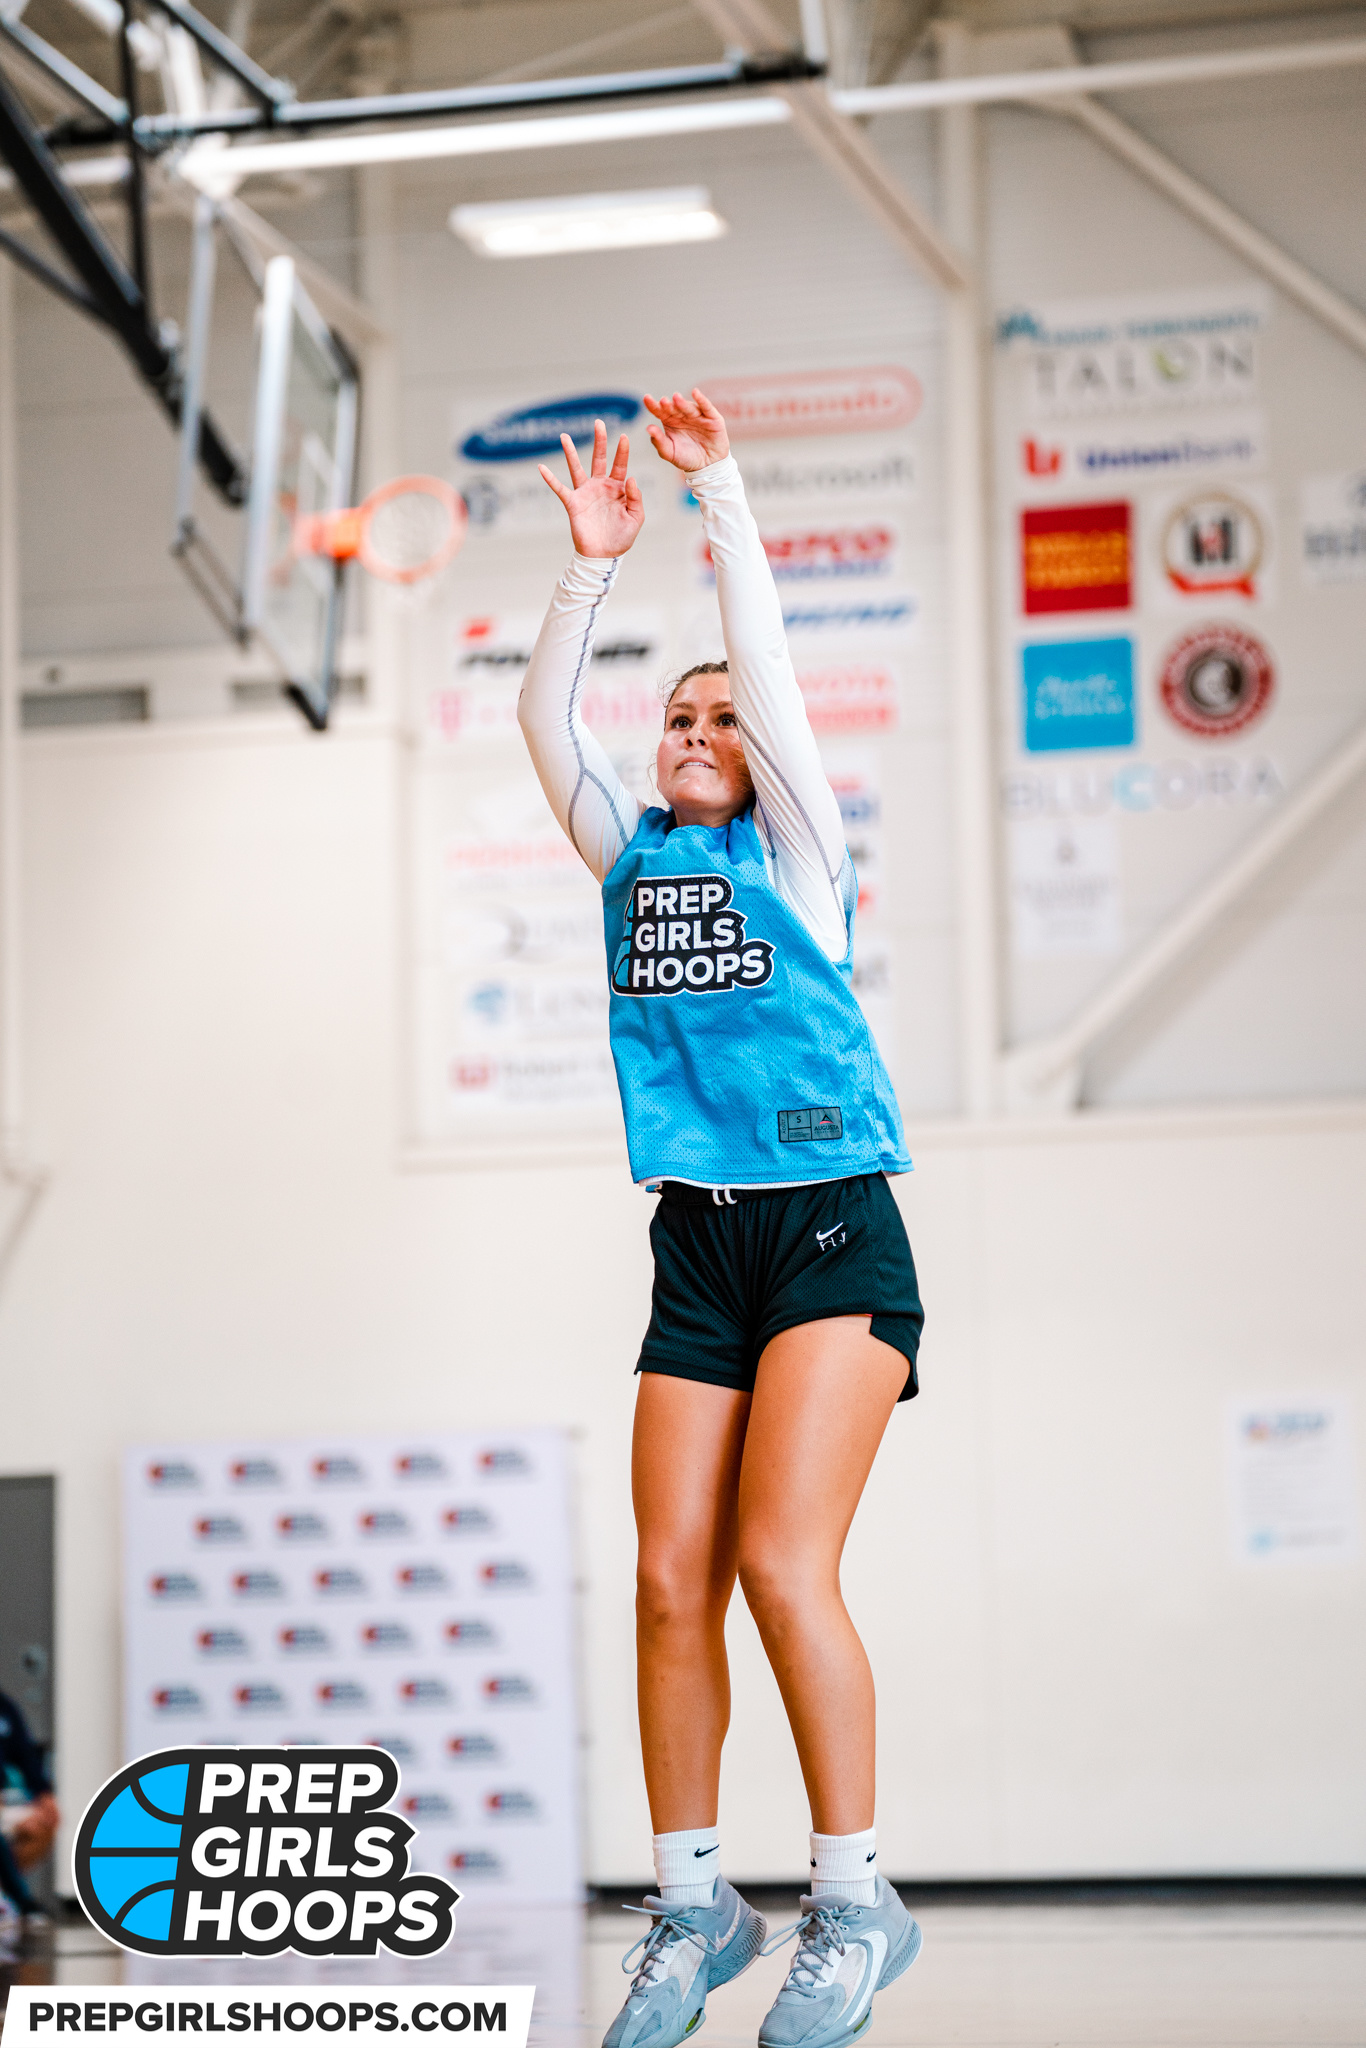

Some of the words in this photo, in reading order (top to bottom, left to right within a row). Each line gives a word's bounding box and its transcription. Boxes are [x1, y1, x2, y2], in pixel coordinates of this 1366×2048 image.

[637, 883, 725, 917] PREP
[634, 917, 737, 953] GIRLS
[632, 948, 766, 988] HOOPS
[796, 1115, 802, 1124] S
